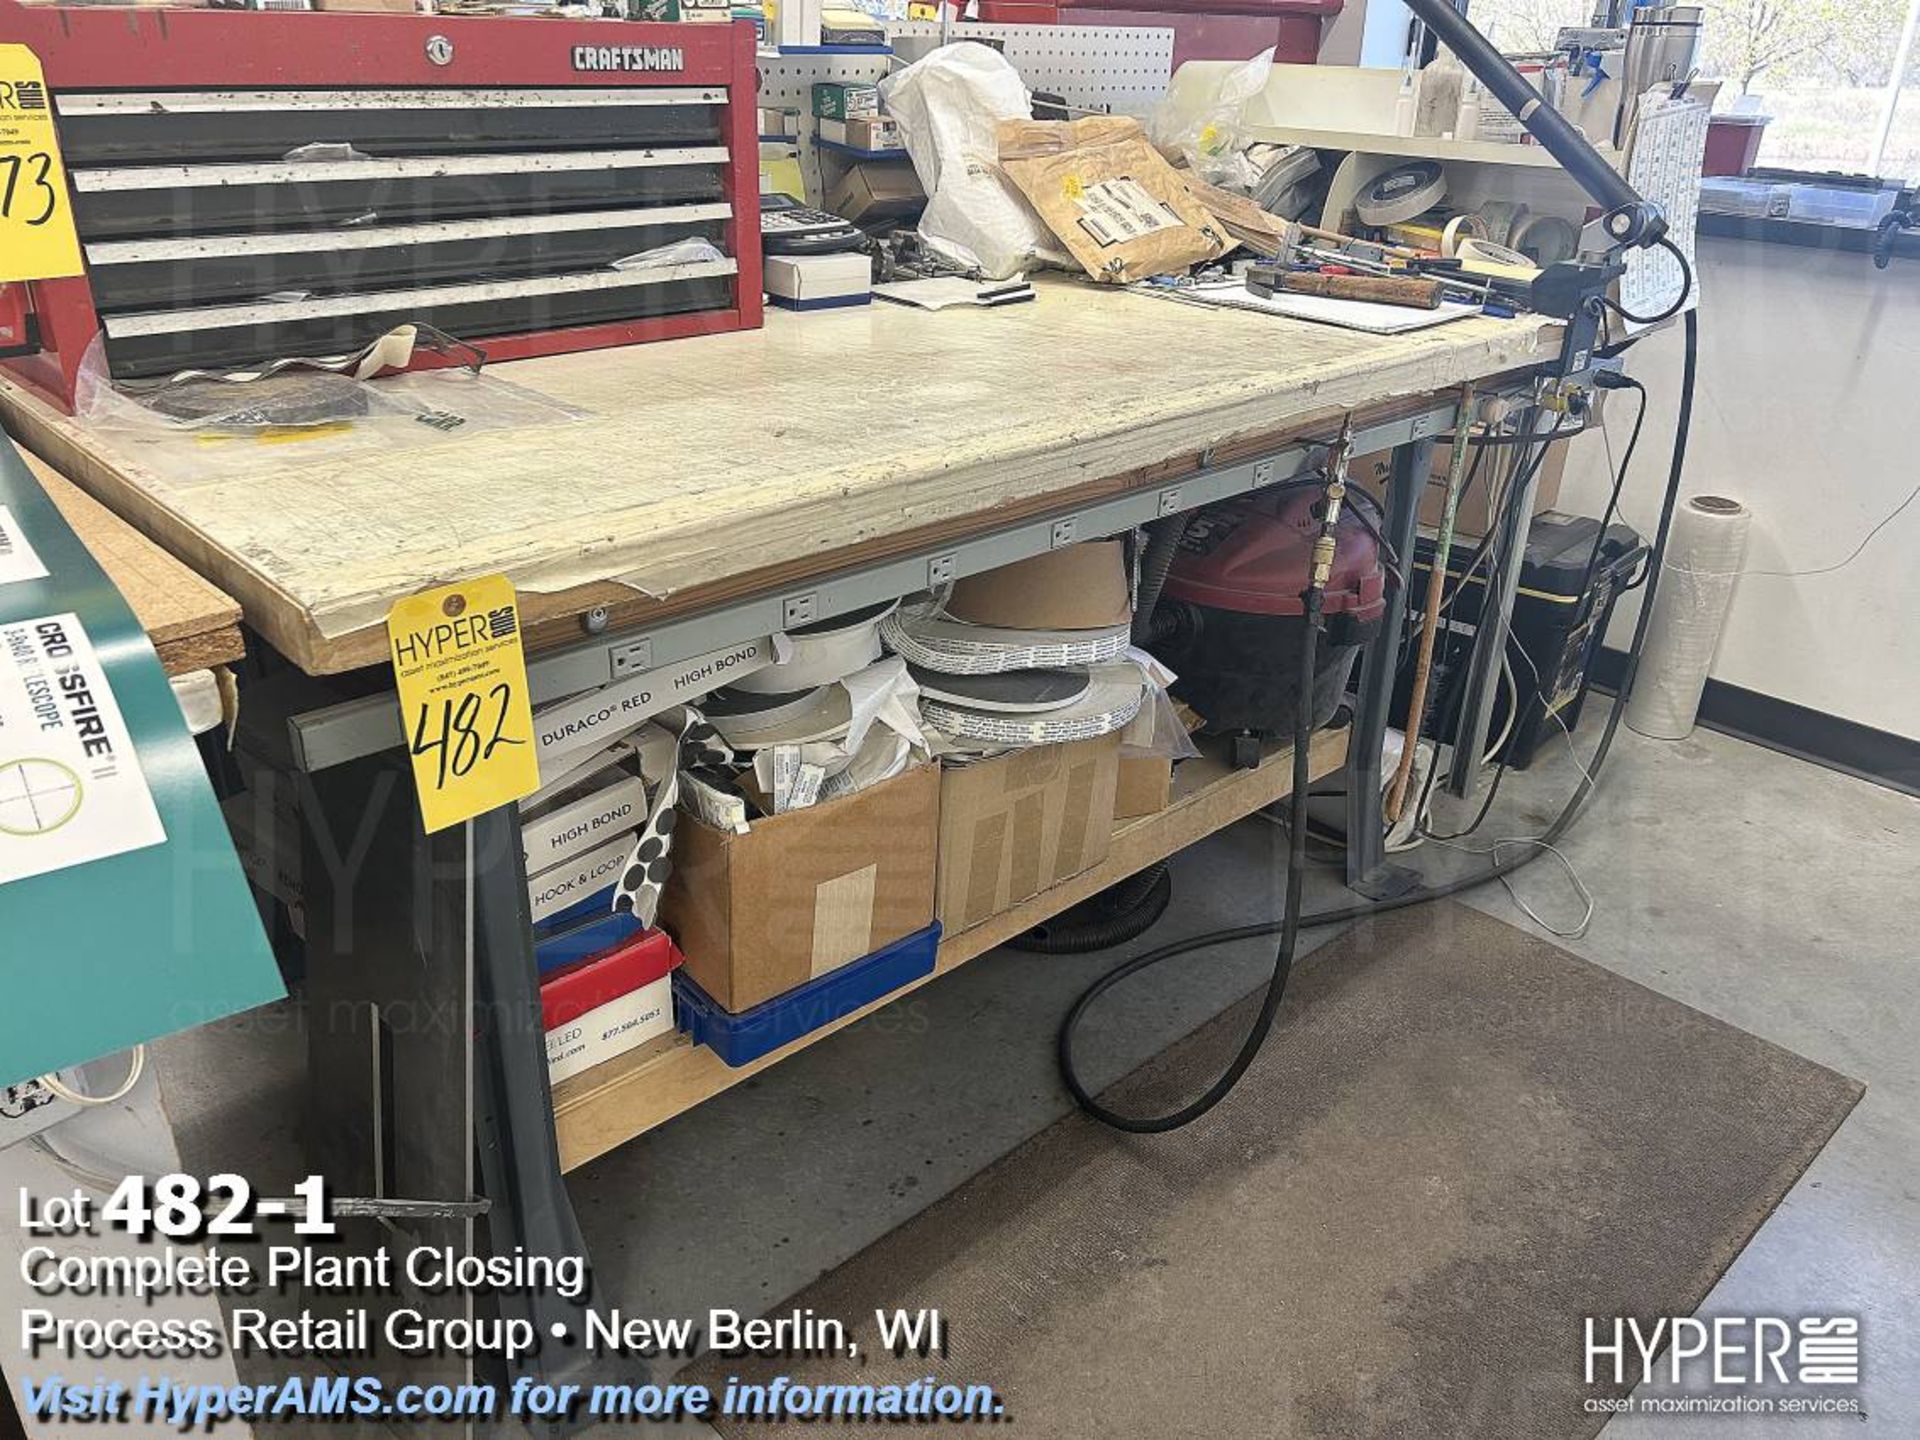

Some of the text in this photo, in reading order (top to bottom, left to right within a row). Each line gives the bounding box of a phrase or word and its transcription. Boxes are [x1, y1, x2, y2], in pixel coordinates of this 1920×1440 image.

[574, 46, 684, 71] CRAFTSMAN
[395, 614, 489, 667] HYPER
[622, 691, 652, 713] RED
[673, 664, 714, 691] HIGH
[715, 645, 758, 672] BOND
[412, 683, 527, 790] 482
[550, 803, 632, 849] HIGH BOND
[535, 854, 625, 907] HOOK & LOOP
[558, 1026, 582, 1047] LED
